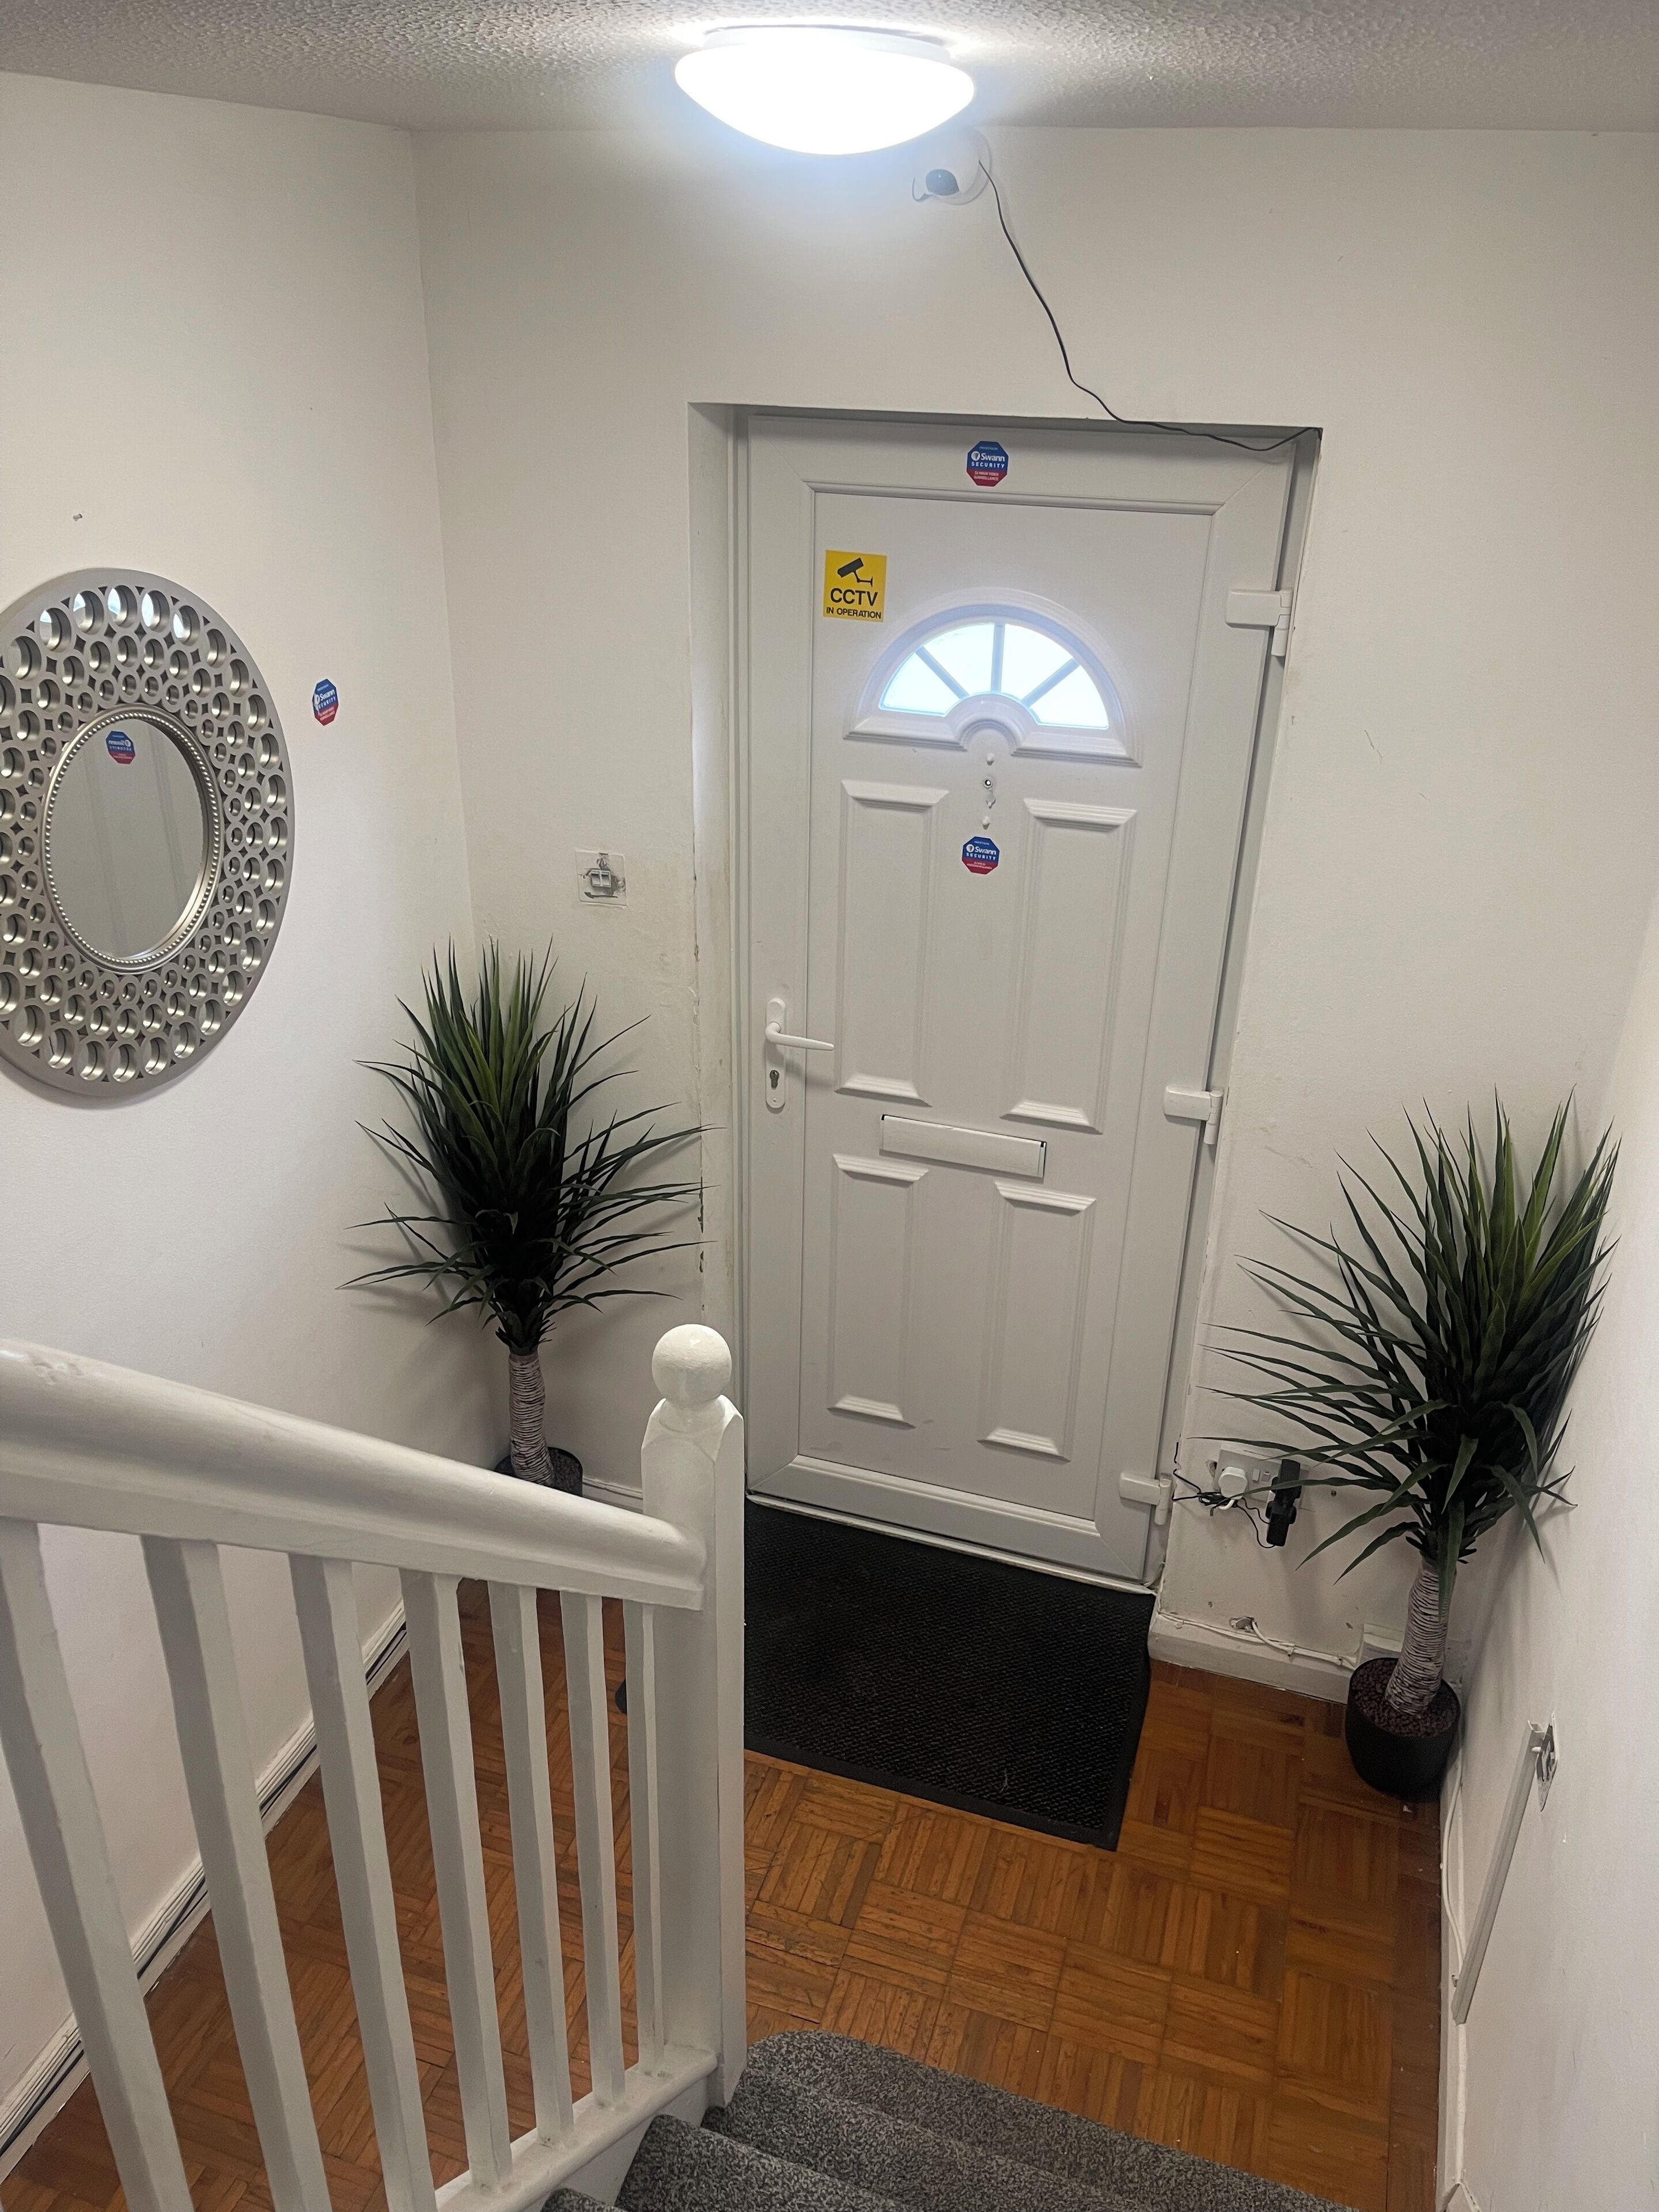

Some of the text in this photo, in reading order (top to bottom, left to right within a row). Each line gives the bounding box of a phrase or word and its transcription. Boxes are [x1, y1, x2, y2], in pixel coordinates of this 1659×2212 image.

[980, 452, 1005, 462] Swann
[830, 588, 878, 607] CCTV
[836, 608, 881, 619] OPERATION
[975, 846, 997, 855] Swann
[966, 853, 996, 861] SECURITY
